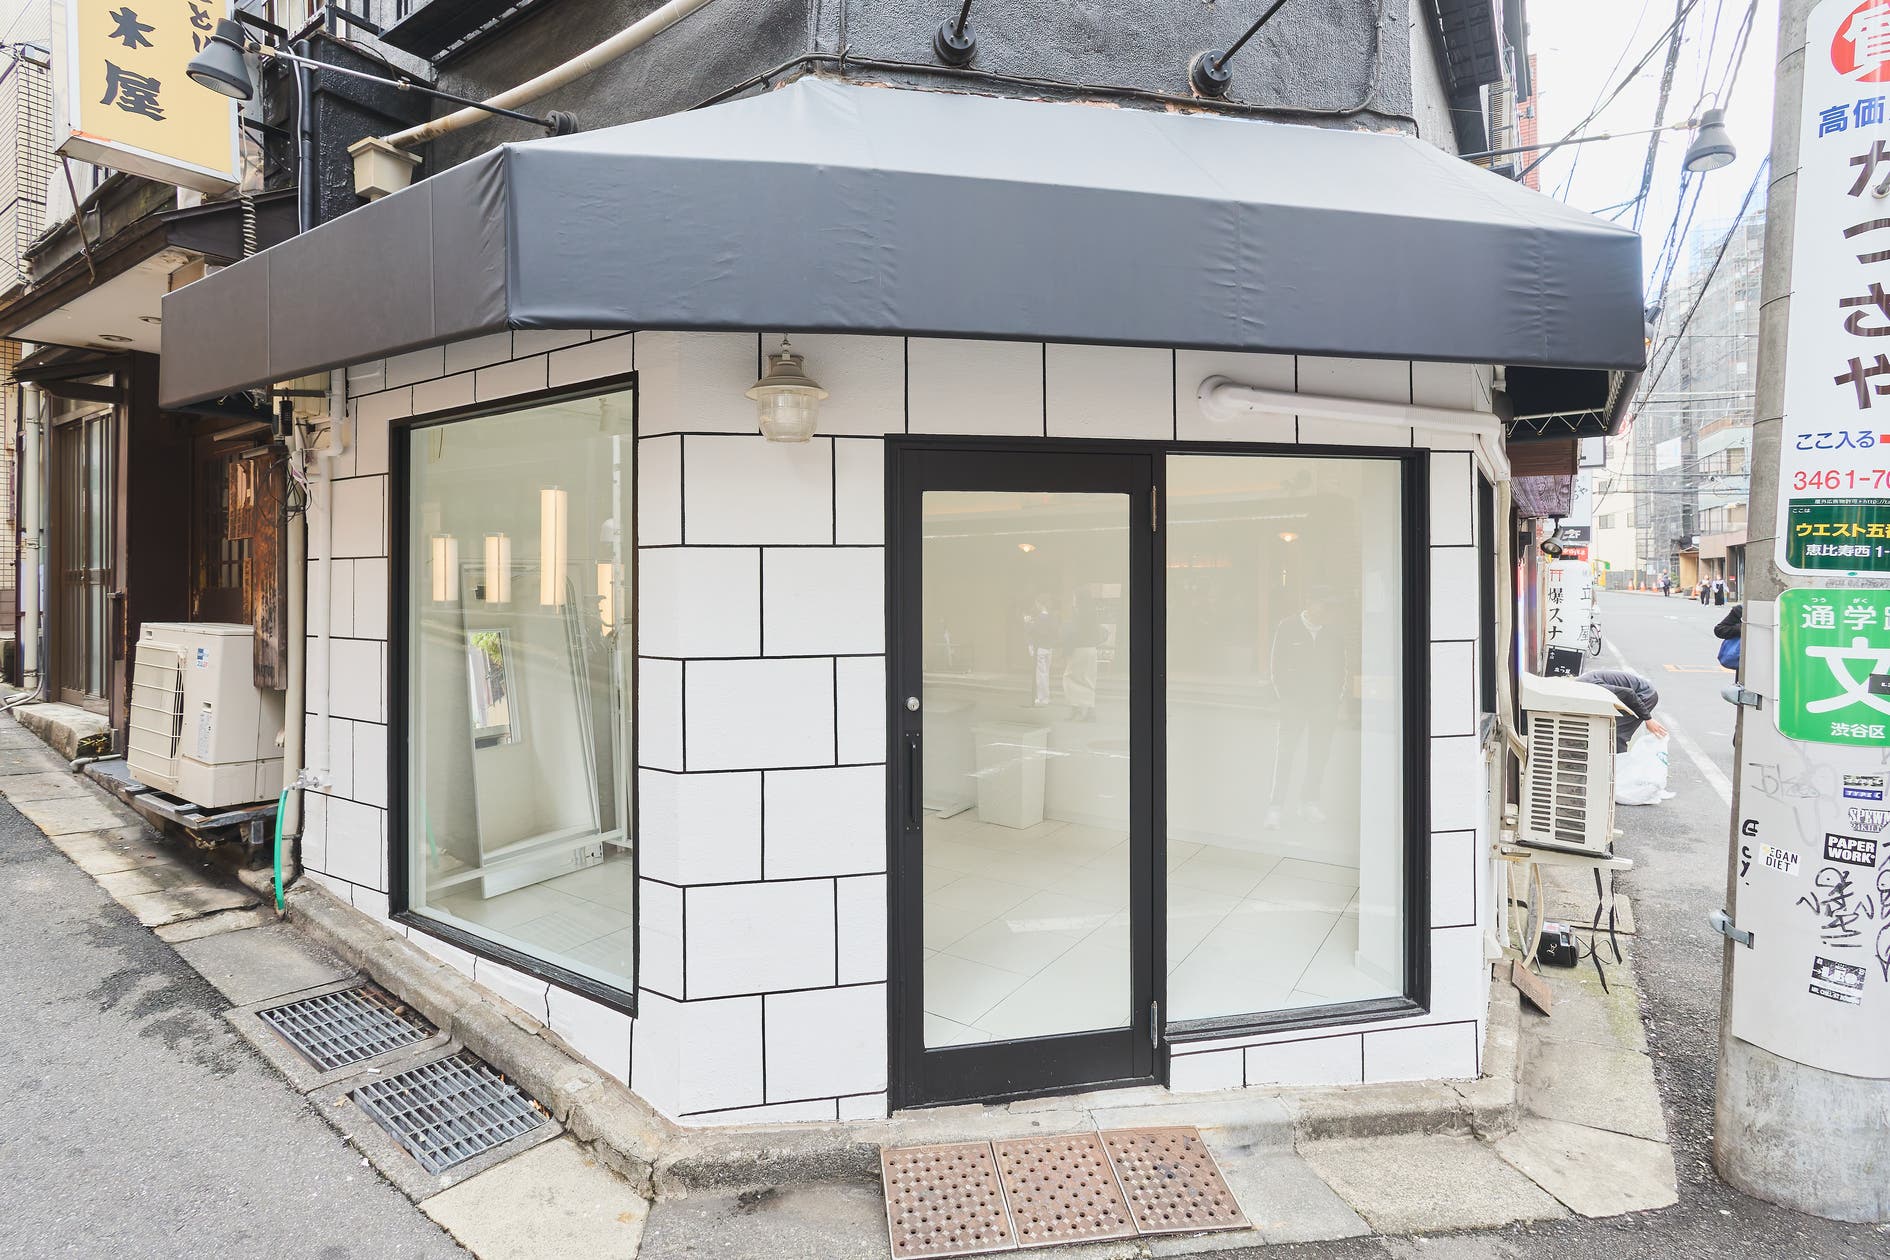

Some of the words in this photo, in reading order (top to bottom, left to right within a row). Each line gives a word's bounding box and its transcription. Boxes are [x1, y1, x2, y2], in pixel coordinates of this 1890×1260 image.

[1818, 96, 1890, 138] 高価
[1796, 430, 1875, 450] ここ入る
[1805, 543, 1871, 557] 恵比寿西
[1830, 722, 1886, 739] 渋谷区
[1828, 835, 1875, 853] PAPER
[1765, 856, 1791, 872] DIET
[1766, 846, 1799, 865] EGAN
[1827, 846, 1872, 864] WORK
